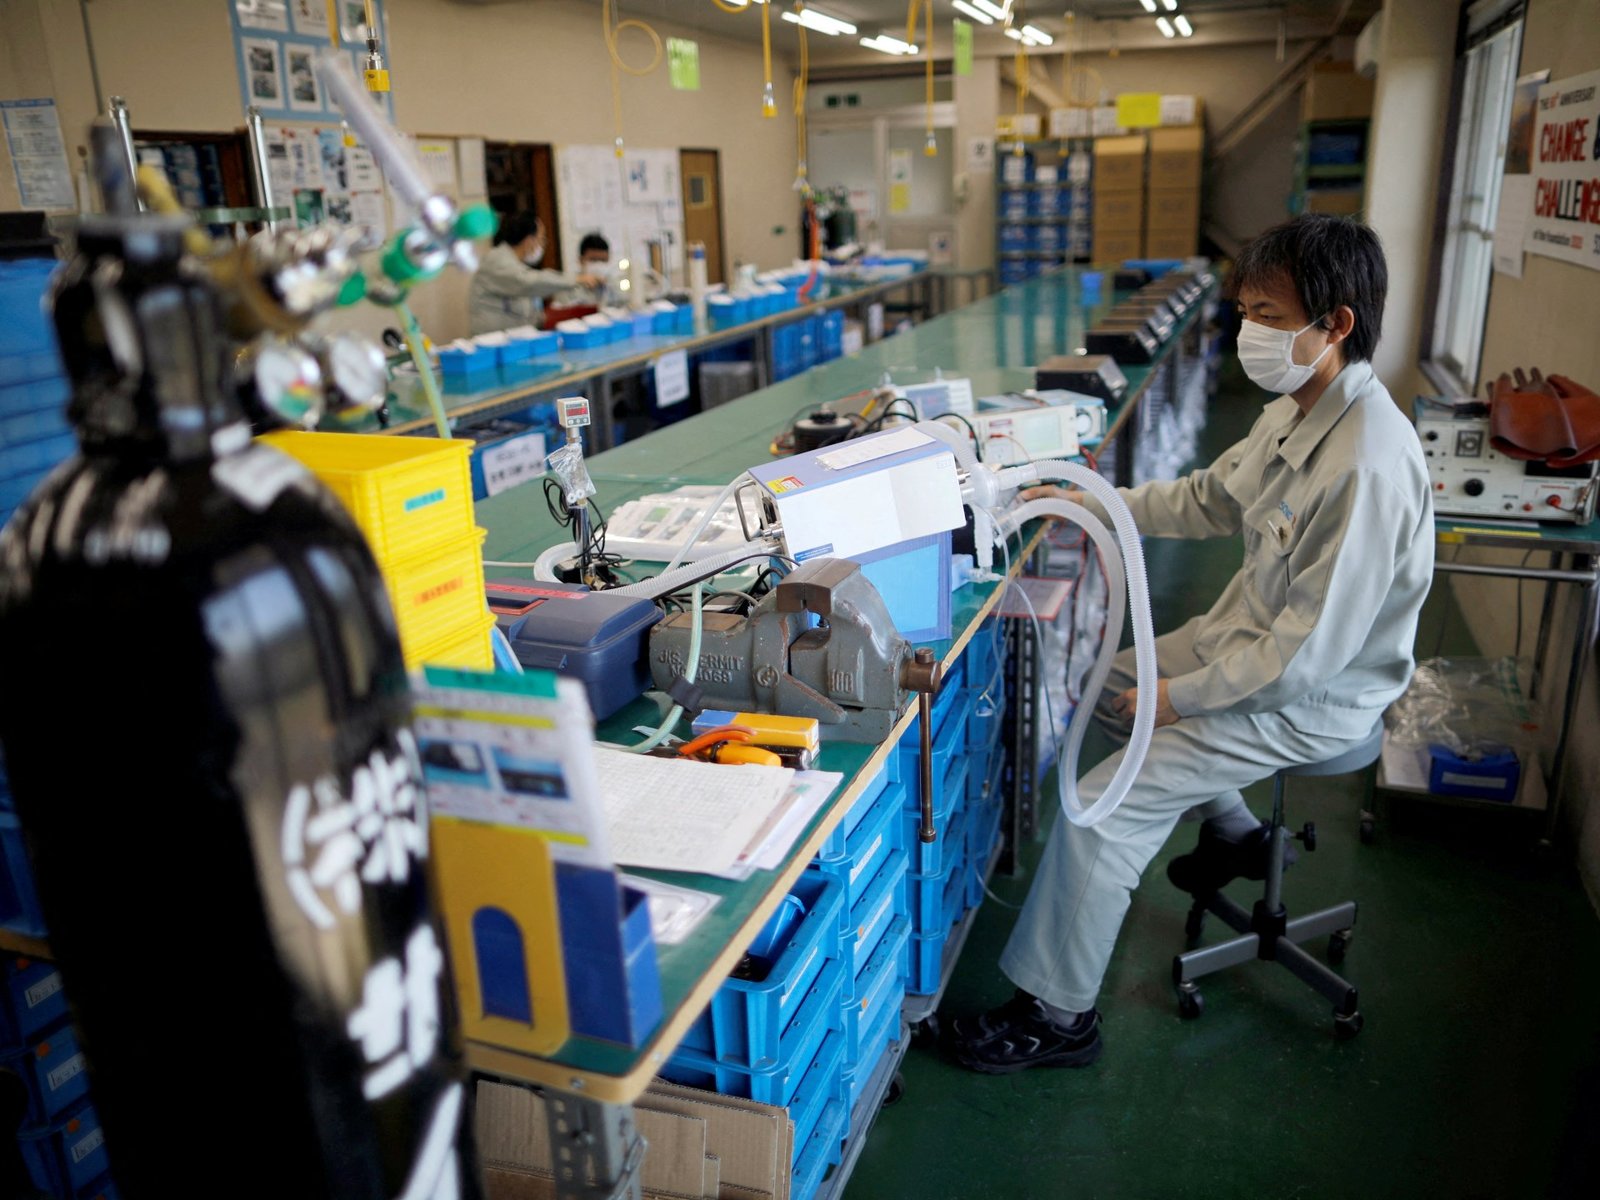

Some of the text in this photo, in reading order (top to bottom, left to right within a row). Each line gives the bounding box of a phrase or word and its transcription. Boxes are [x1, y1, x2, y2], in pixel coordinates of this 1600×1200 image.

[1540, 118, 1589, 162] CHANGE
[1535, 177, 1600, 224] CHALLENG
[698, 652, 743, 670] ERMIT
